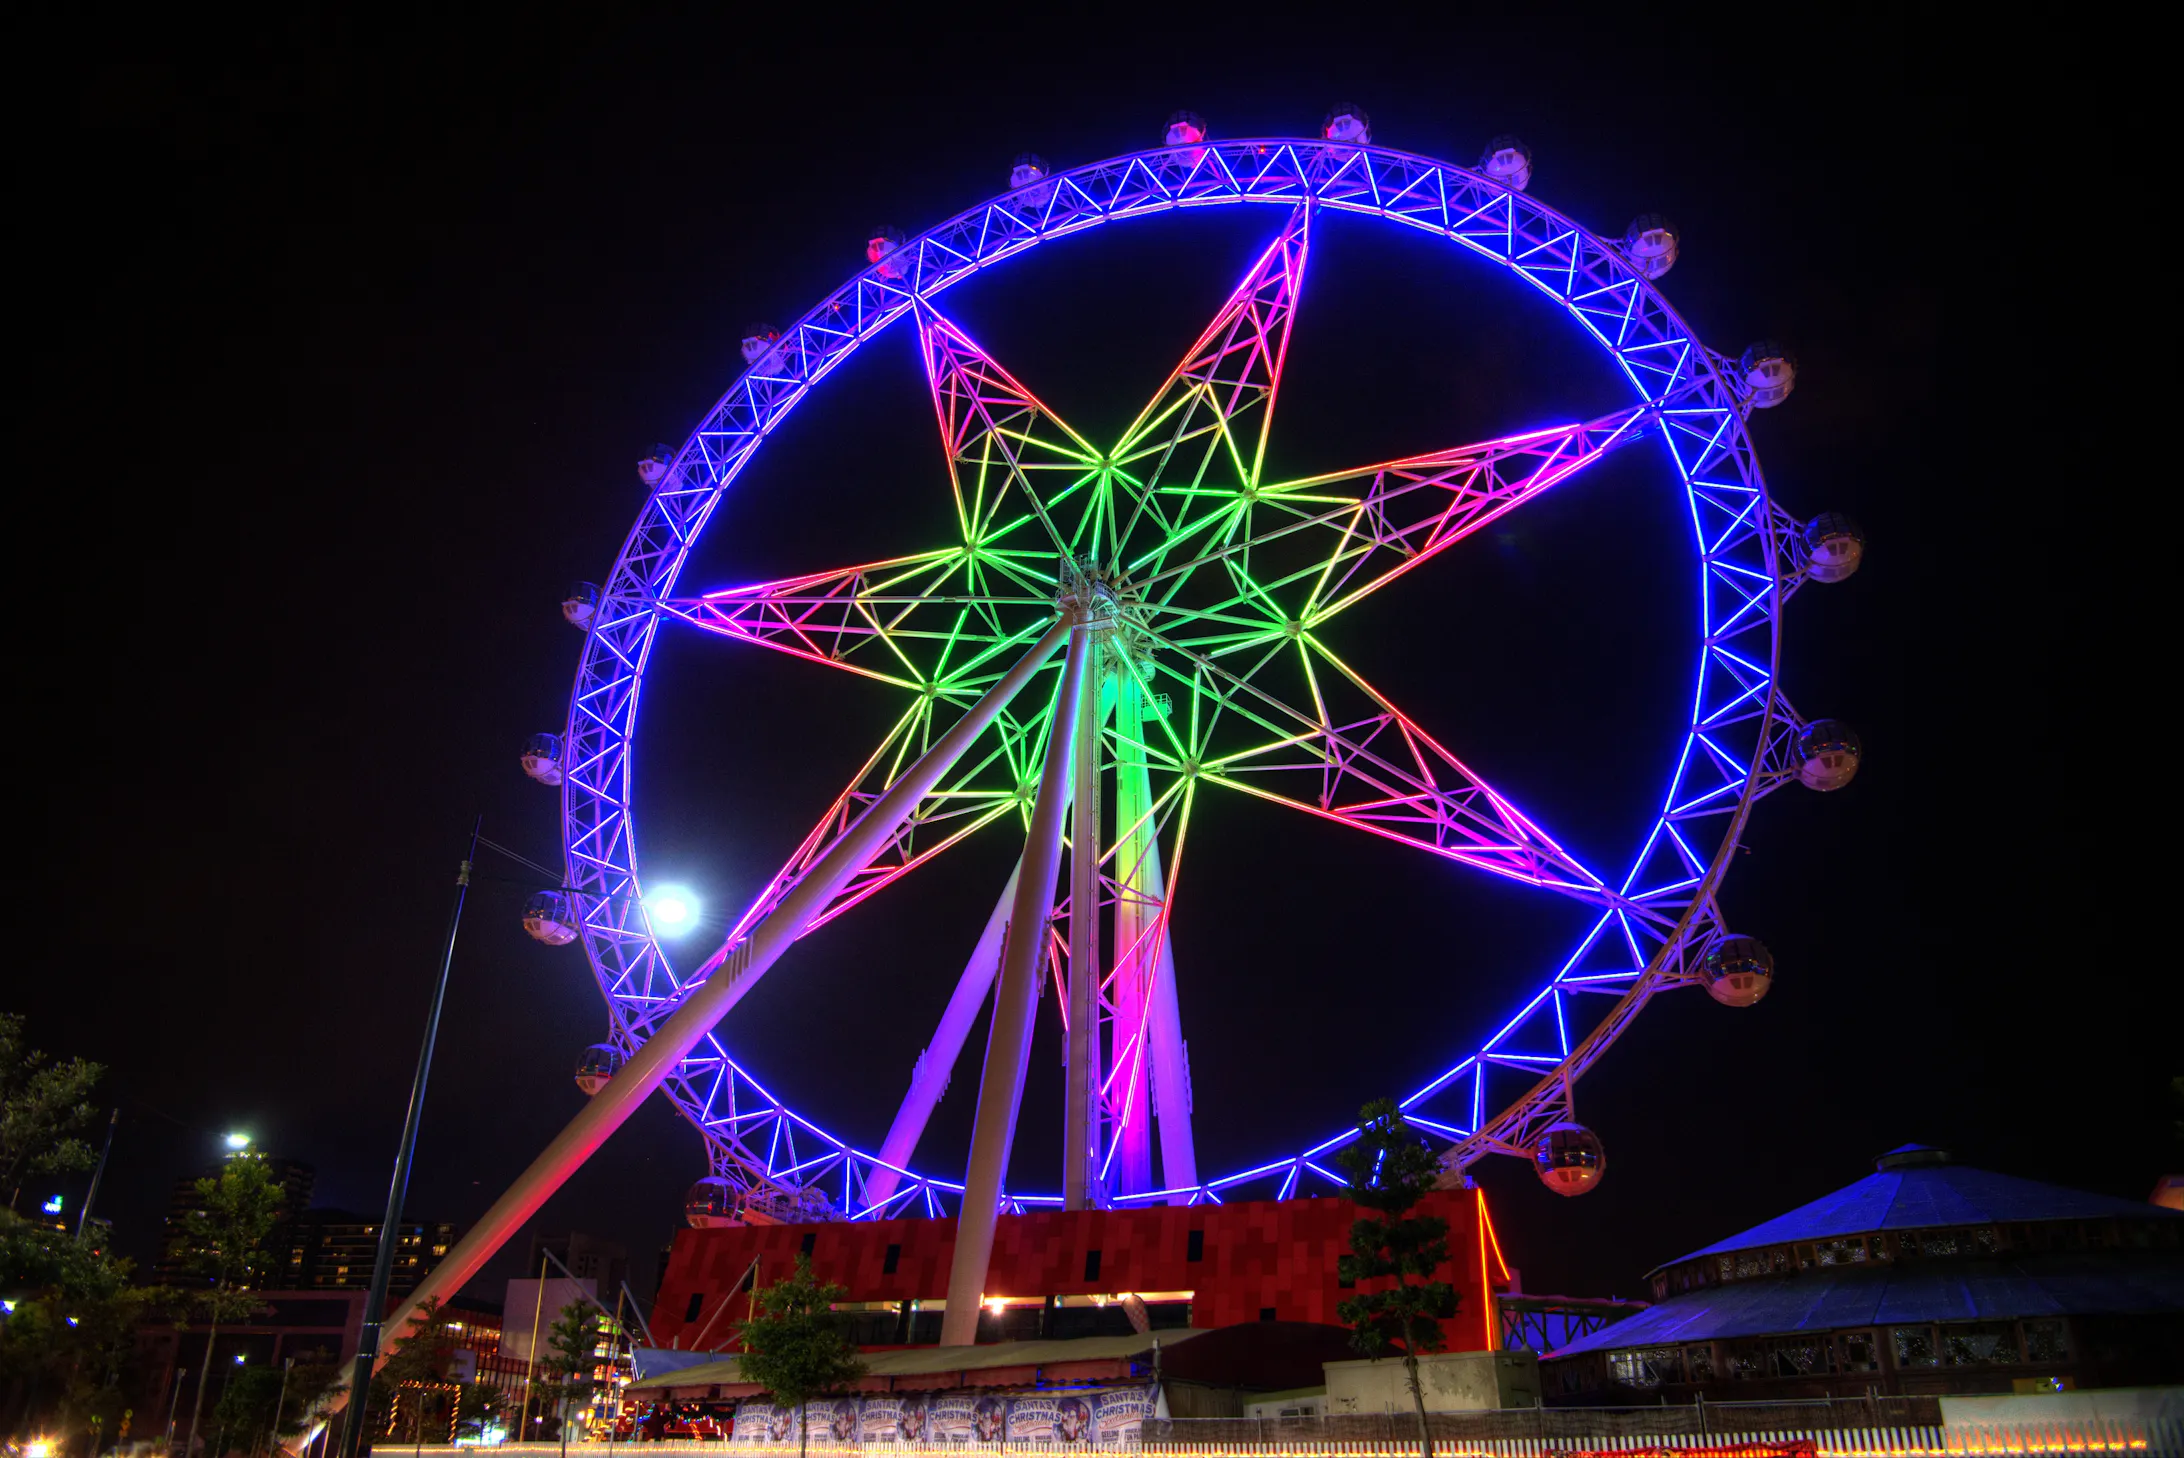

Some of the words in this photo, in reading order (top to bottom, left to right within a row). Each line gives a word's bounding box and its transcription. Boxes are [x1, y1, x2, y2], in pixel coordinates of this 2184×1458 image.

[860, 1410, 903, 1422] CHRISTMAS
[930, 1410, 978, 1422] CHRISTMAS
[1096, 1404, 1153, 1419] CHRISTMAS
[736, 1414, 773, 1425] CHRISTMAS
[795, 1413, 836, 1424] CRISTMAS
[1008, 1411, 1061, 1425] CHRISTMAS
